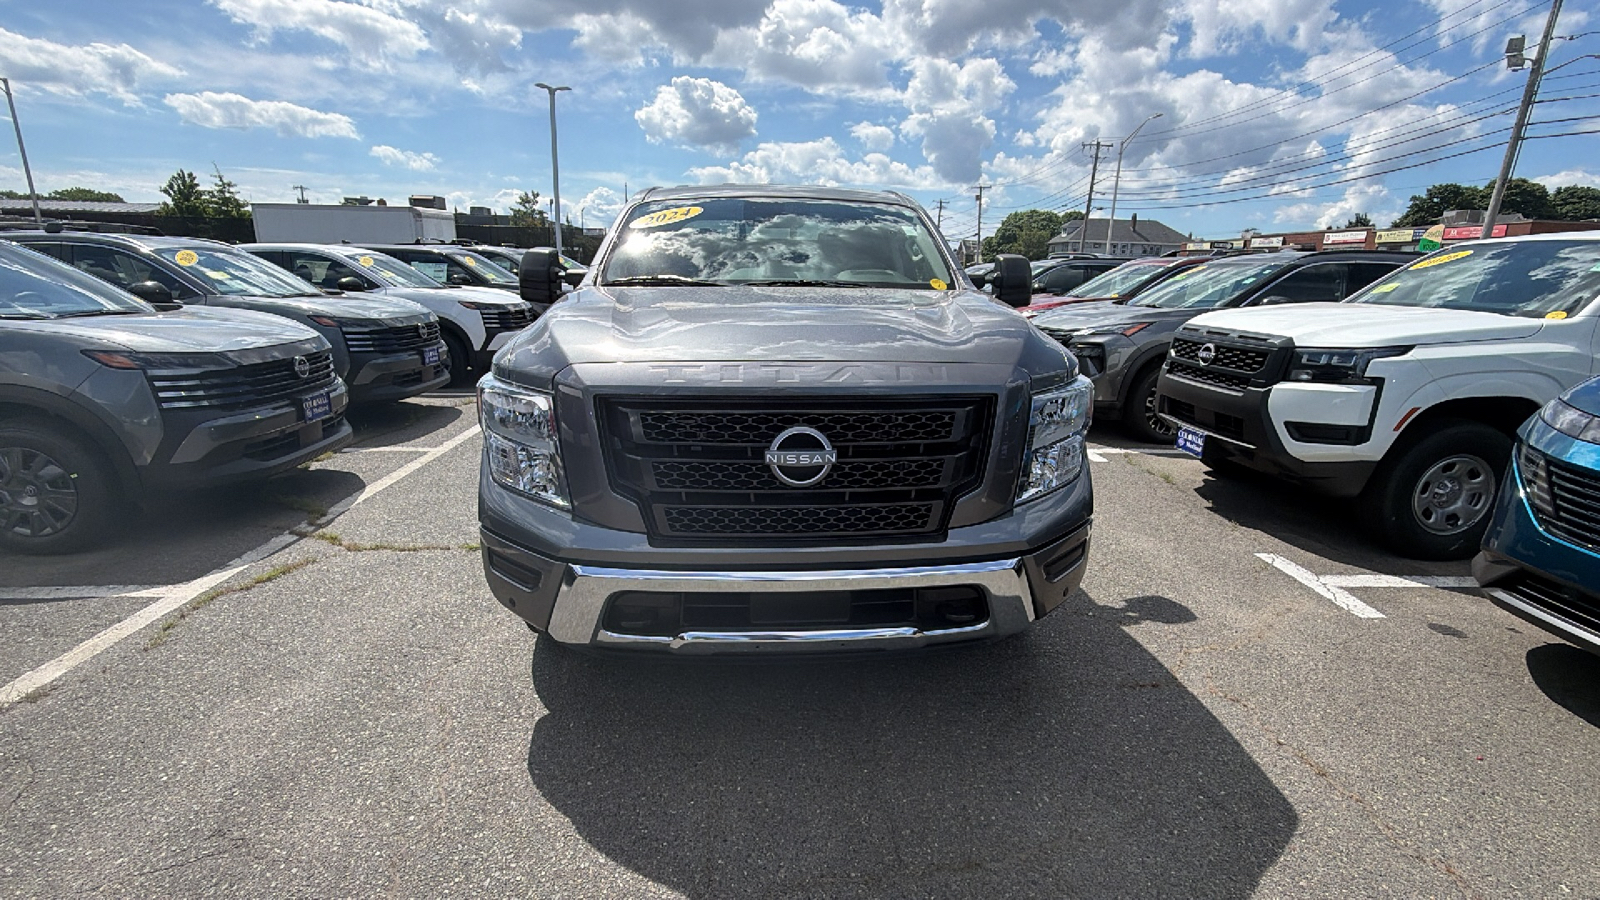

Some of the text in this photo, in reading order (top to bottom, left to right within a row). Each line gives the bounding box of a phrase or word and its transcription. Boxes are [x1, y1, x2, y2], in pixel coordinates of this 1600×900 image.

[645, 207, 692, 226] 2024
[648, 364, 949, 383] TITAN
[766, 452, 836, 464] NISSAN
